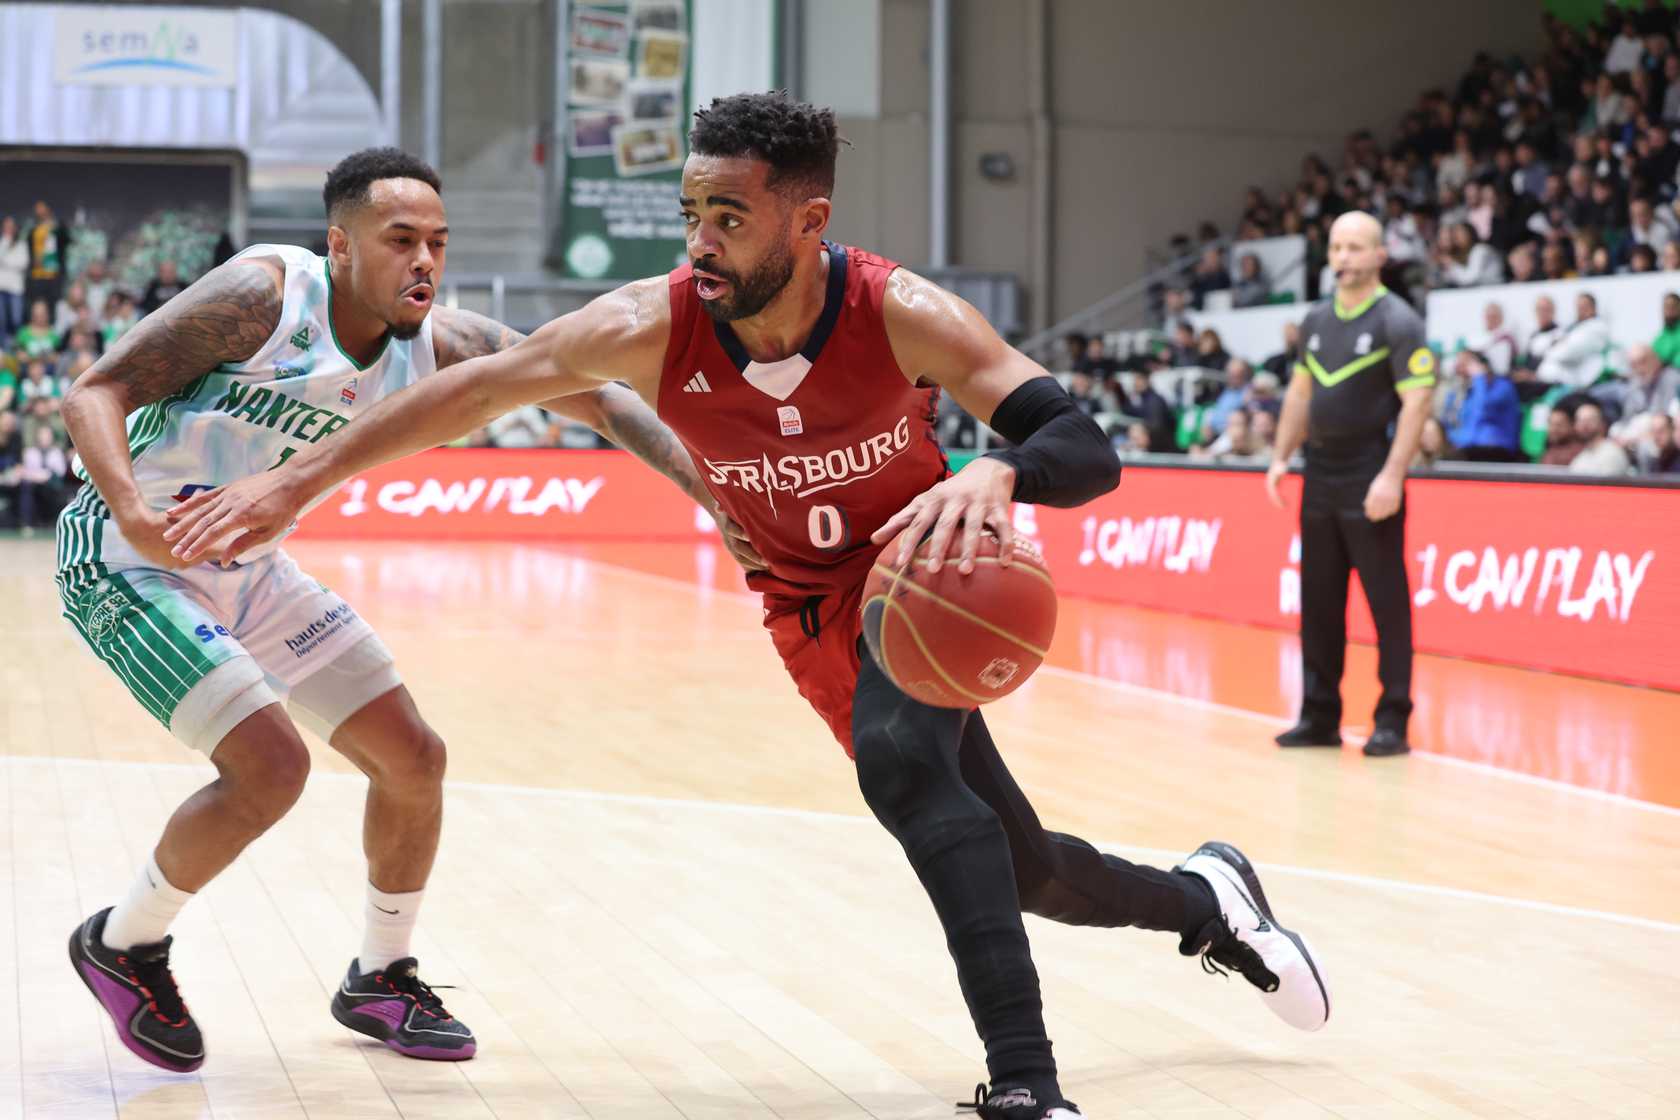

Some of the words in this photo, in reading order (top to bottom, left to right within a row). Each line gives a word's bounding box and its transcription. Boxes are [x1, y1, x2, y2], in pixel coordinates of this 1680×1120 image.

[704, 416, 910, 503] STRASBOURG
[377, 478, 487, 517] CAN
[483, 475, 606, 517] PLAY
[1097, 516, 1156, 570] CAN
[1152, 515, 1223, 573] PLAY
[1444, 546, 1539, 613] CAN
[1533, 546, 1655, 623] PLAY
